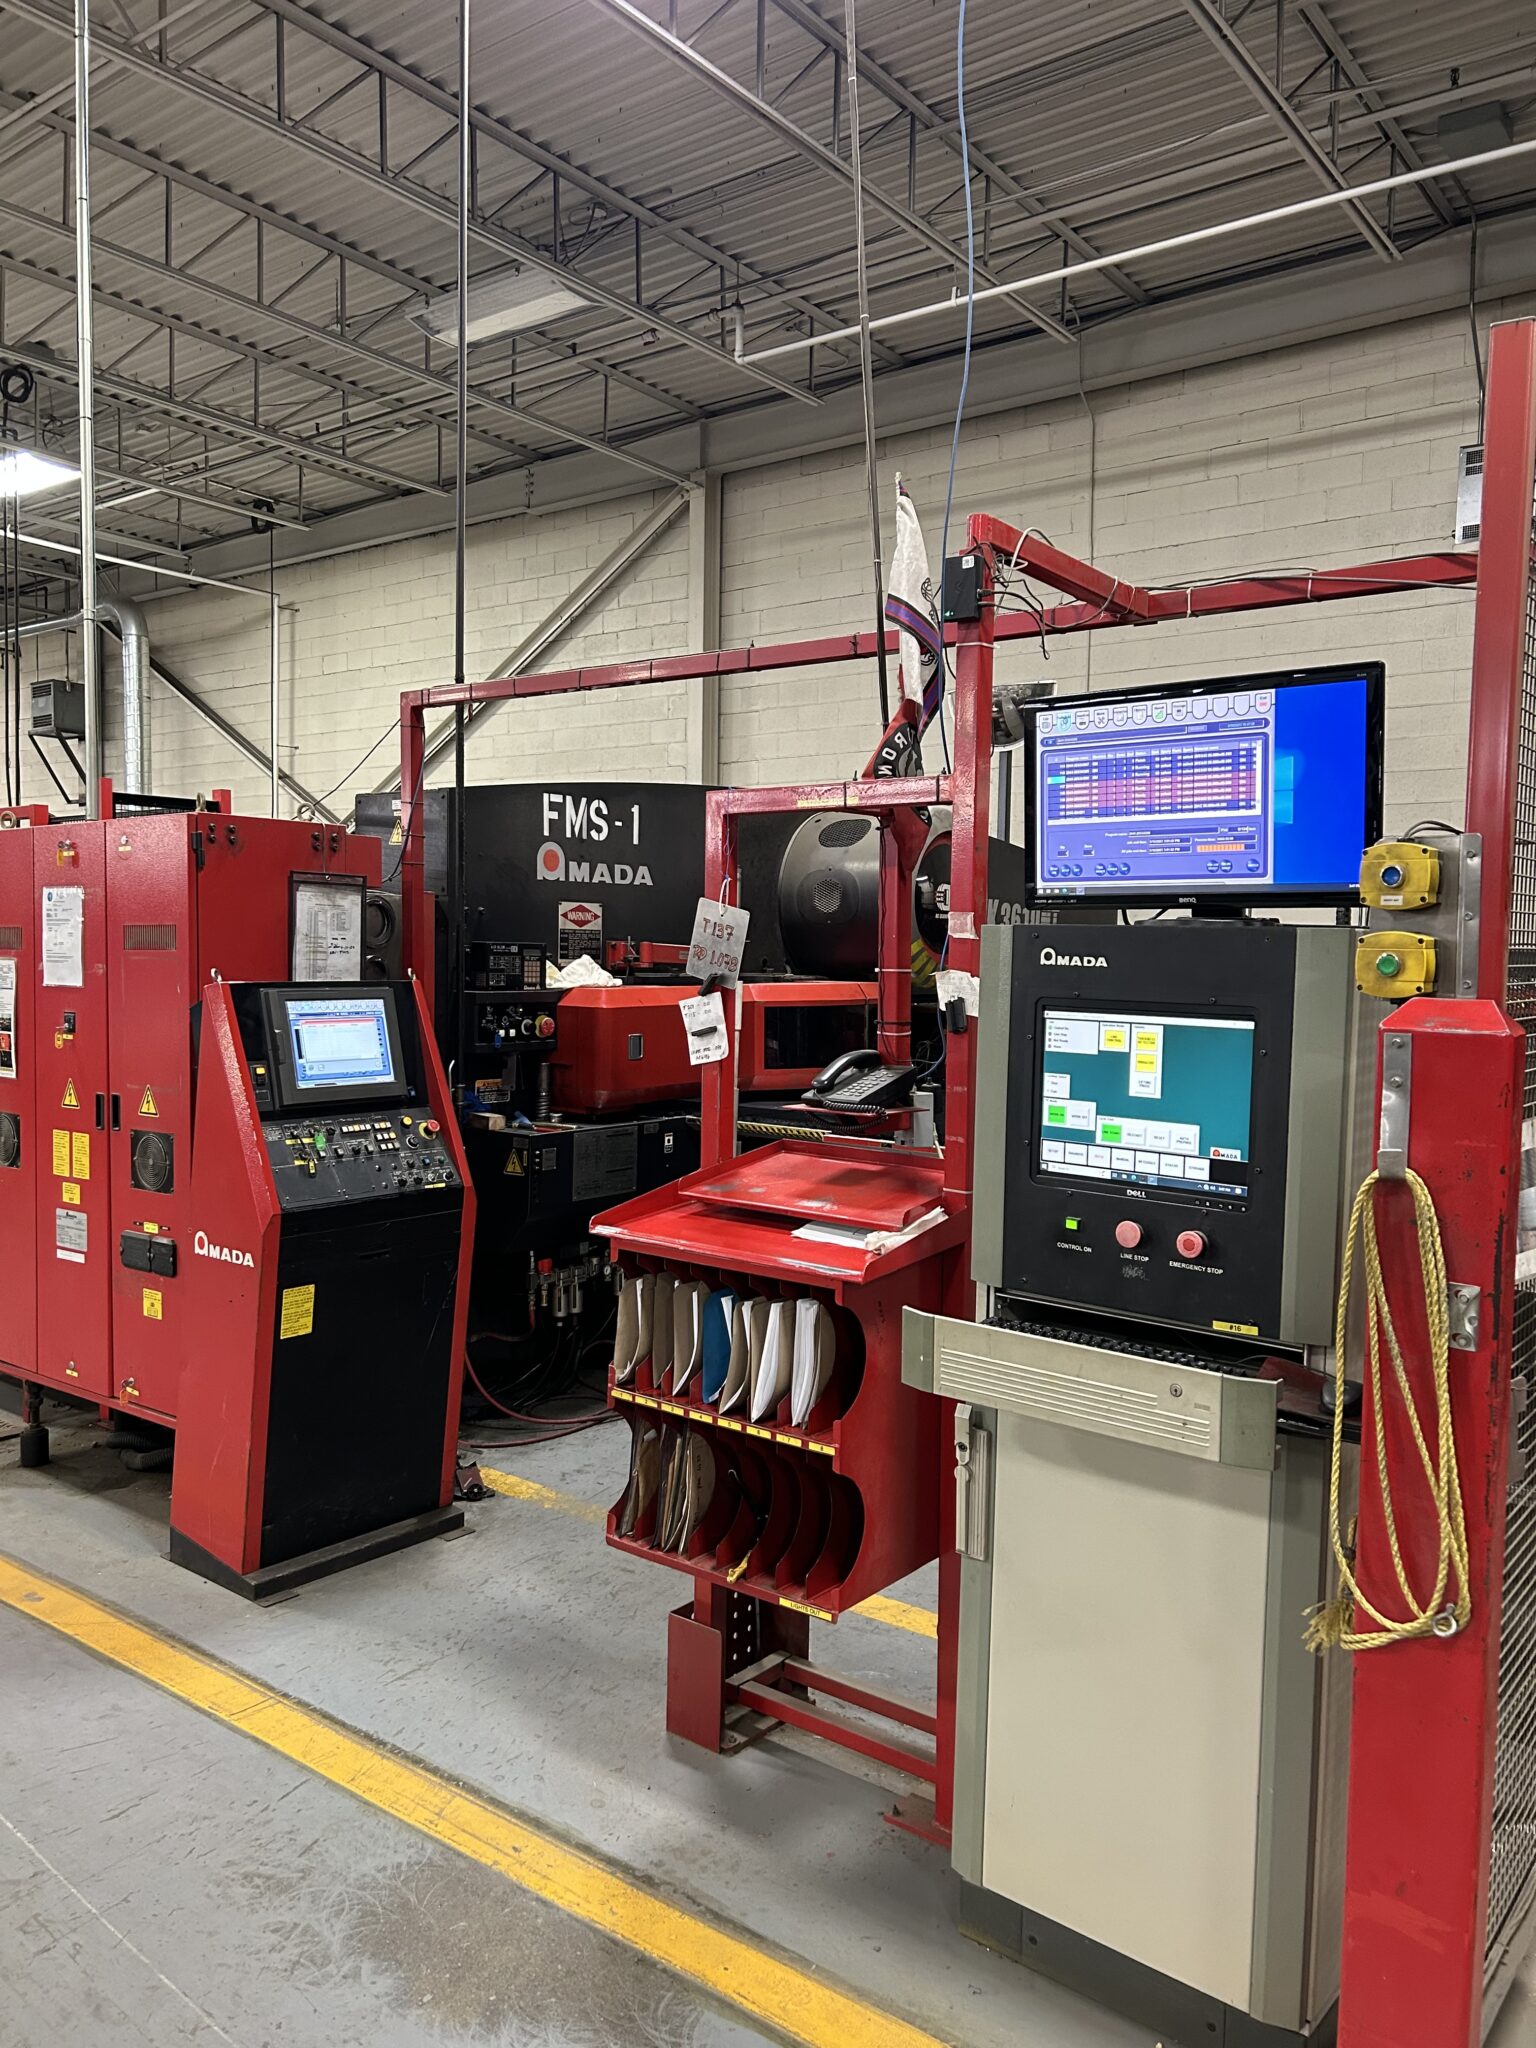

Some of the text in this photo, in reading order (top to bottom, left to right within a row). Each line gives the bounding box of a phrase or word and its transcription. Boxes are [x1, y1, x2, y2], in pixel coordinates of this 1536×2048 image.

[537, 841, 653, 886] AMADA
[567, 911, 595, 921] WARNING
[1040, 947, 1108, 968] AMADA
[1127, 1189, 1146, 1198] DELL
[194, 1231, 254, 1267] AMADA
[1057, 1242, 1082, 1251] CONTROL
[1133, 1254, 1149, 1262] STOP
[1169, 1261, 1223, 1275] EMERGENCY STOP
[1229, 1324, 1242, 1332] #16
[790, 1602, 820, 1616] LIGHTS OUT
